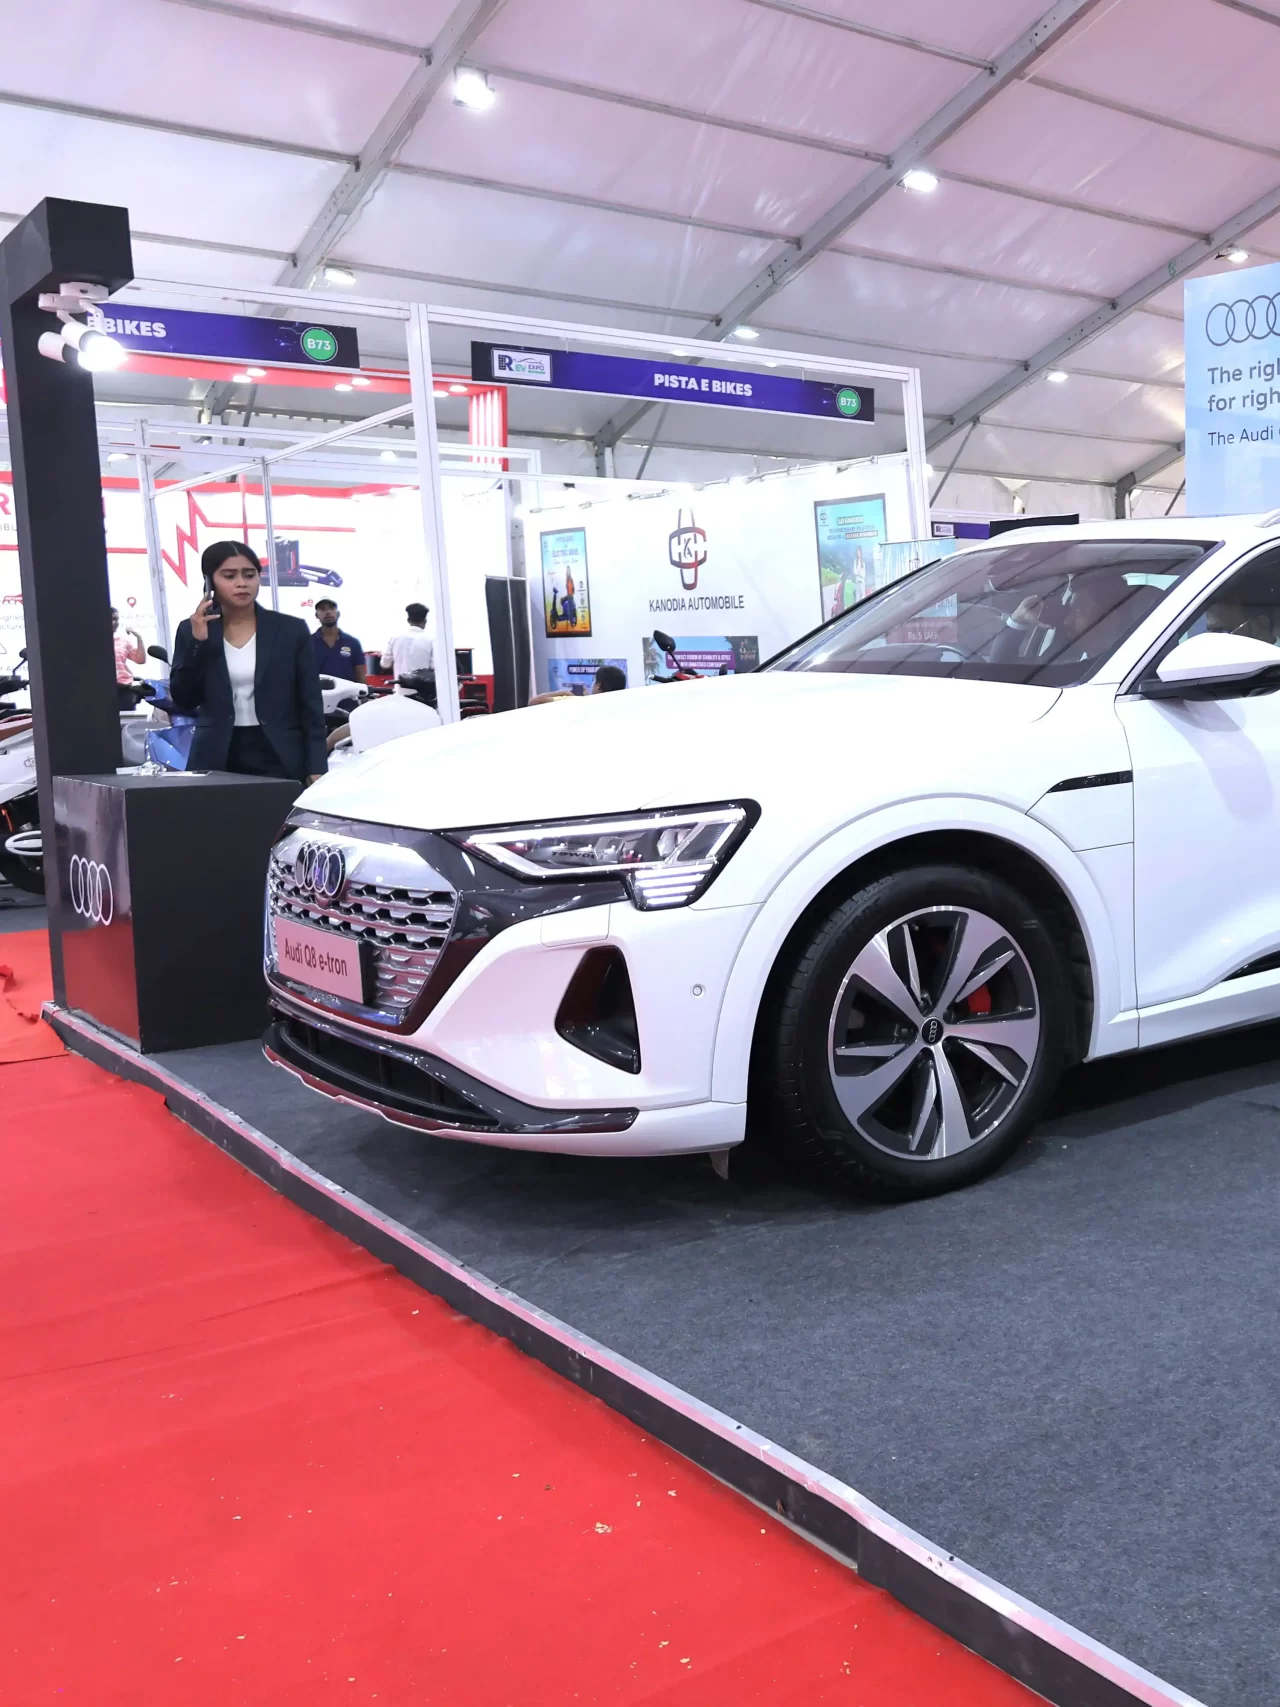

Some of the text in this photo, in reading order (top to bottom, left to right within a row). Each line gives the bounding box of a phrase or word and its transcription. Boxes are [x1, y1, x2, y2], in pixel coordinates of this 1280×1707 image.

[105, 317, 167, 338] BIKES
[307, 337, 331, 351] B73
[1208, 366, 1243, 384] The
[654, 373, 753, 397] PISTA E BIKES
[840, 397, 857, 407] B73
[1208, 394, 1236, 412] for
[1208, 432, 1235, 446] The
[1239, 425, 1274, 443] Audi
[649, 595, 745, 612] KANODIA AUTOMOBILE
[285, 938, 348, 976] Audi Q8 e-tron
